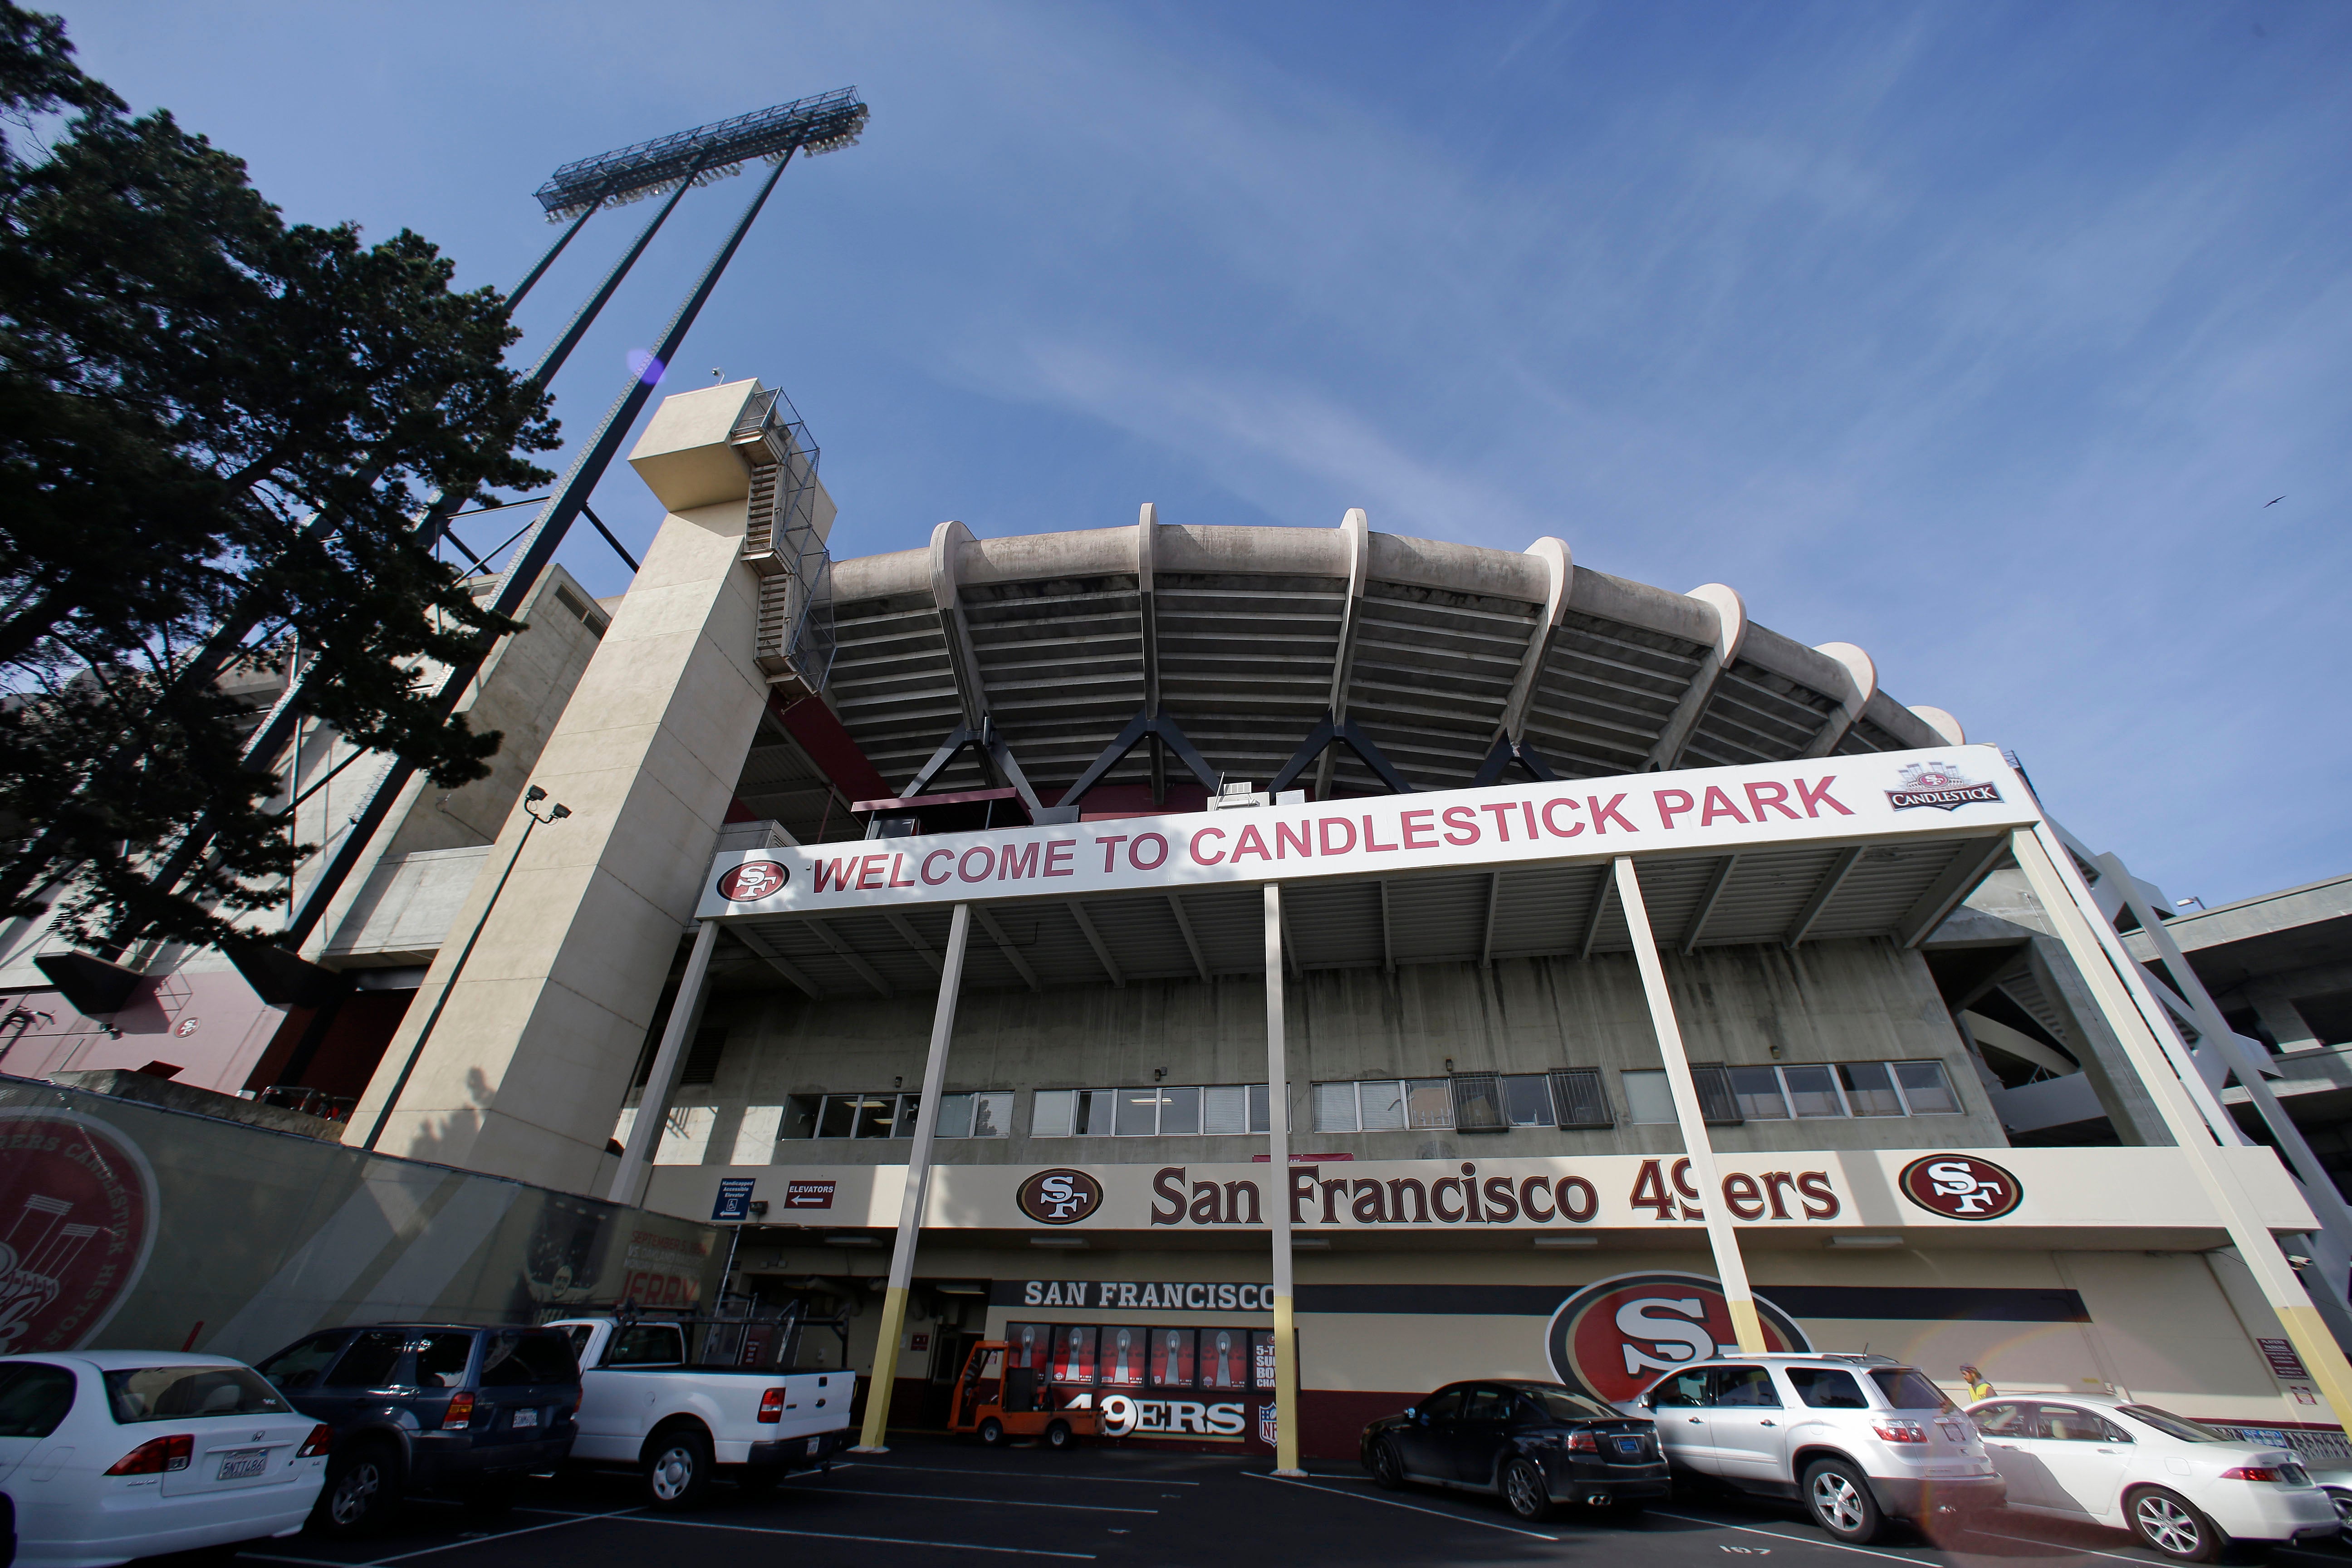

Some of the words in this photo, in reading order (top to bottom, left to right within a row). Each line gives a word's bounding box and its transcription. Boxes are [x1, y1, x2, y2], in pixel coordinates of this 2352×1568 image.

[1893, 787, 1997, 806] CANDLESTICK
[814, 840, 1076, 893] WELCOME
[1096, 833, 1168, 873] TO
[1190, 794, 1635, 866] CANDLESTICK
[1653, 776, 1855, 829] PARK
[1151, 1166, 1264, 1226] San
[1289, 1161, 1599, 1224] Francisco
[632, 1230, 680, 1249] SEPTEMBER
[615, 1271, 699, 1307] JERRY
[1024, 1281, 1088, 1306] SAN
[1099, 1282, 1274, 1310] FRANCISCO
[36, 1264, 118, 1352] HISTOR
